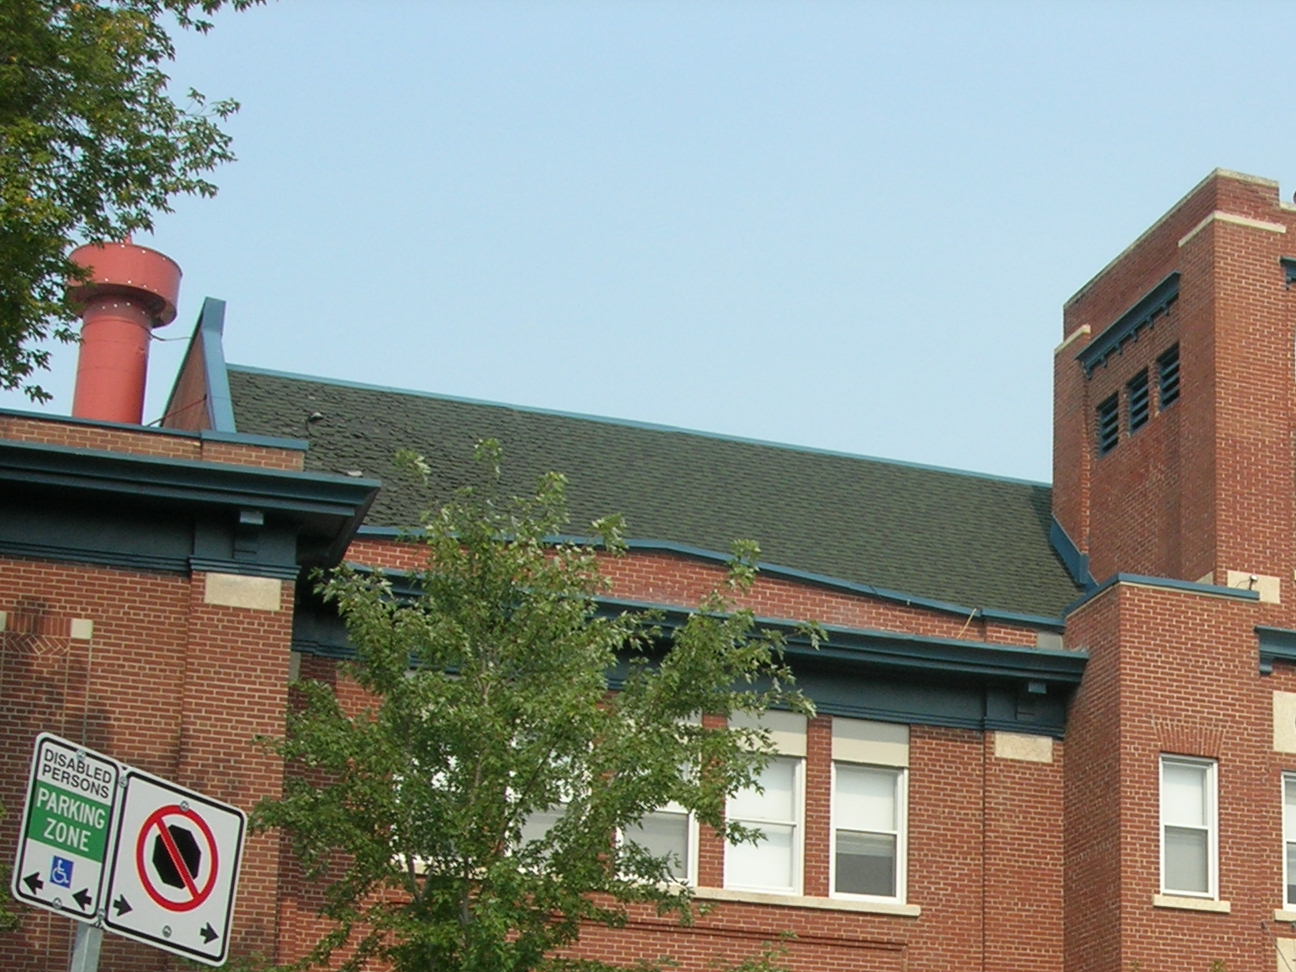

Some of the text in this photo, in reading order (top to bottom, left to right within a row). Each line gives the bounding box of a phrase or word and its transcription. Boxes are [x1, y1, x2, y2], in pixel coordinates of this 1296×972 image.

[42, 764, 109, 799] PERSONS
[44, 748, 112, 784] DISABLED
[37, 787, 106, 829] PARKING
[43, 817, 92, 852] ZONE
